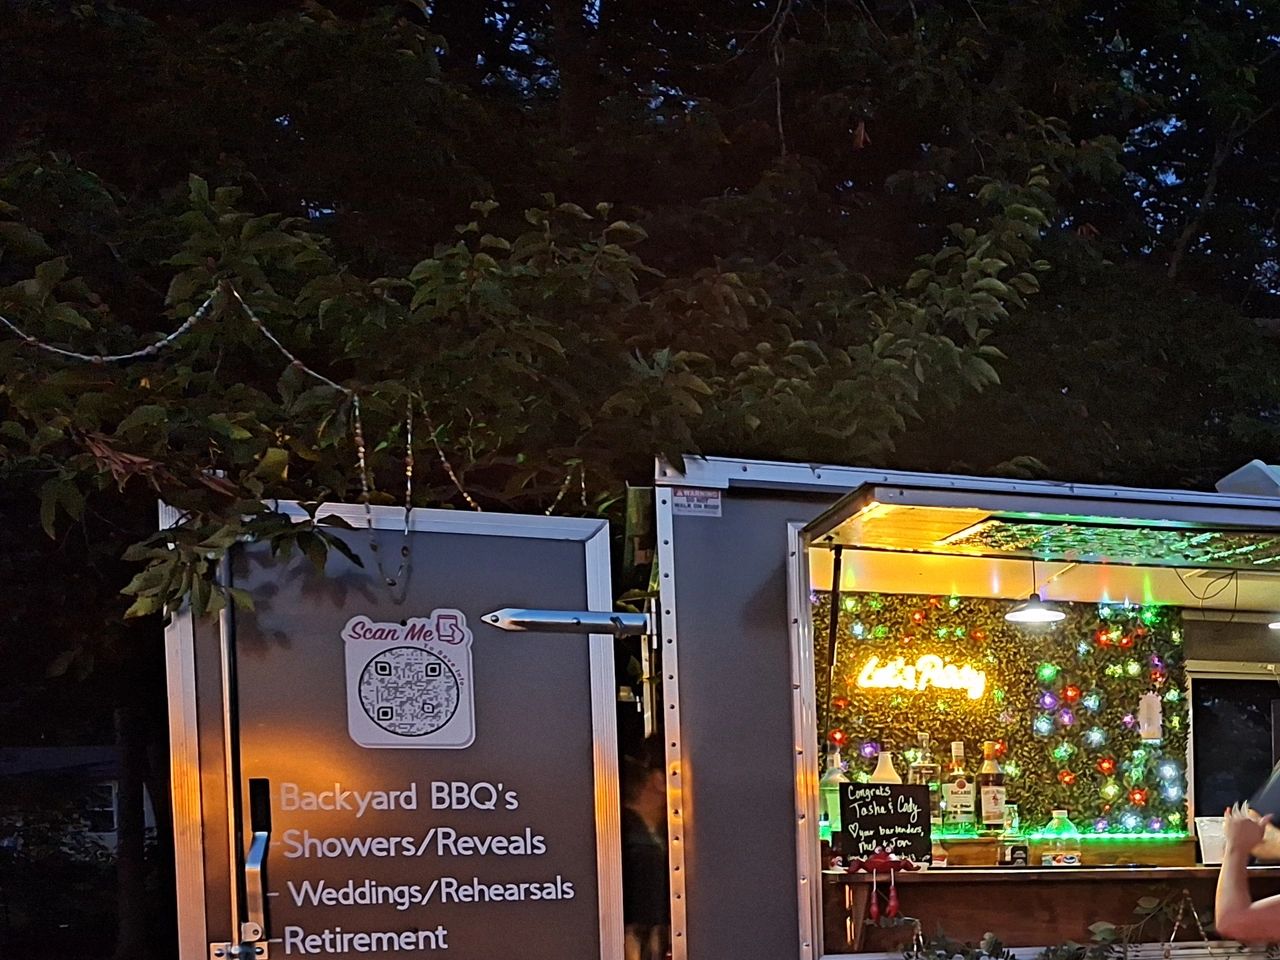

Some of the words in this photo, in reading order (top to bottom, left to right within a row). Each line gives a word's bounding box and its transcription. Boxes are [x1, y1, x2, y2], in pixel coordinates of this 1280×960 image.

[348, 621, 400, 641] Scan
[403, 623, 434, 641] Me
[280, 782, 417, 818] Backyard
[430, 781, 519, 811] BBQ's
[847, 785, 891, 802] Congrats
[897, 795, 922, 824] Cody
